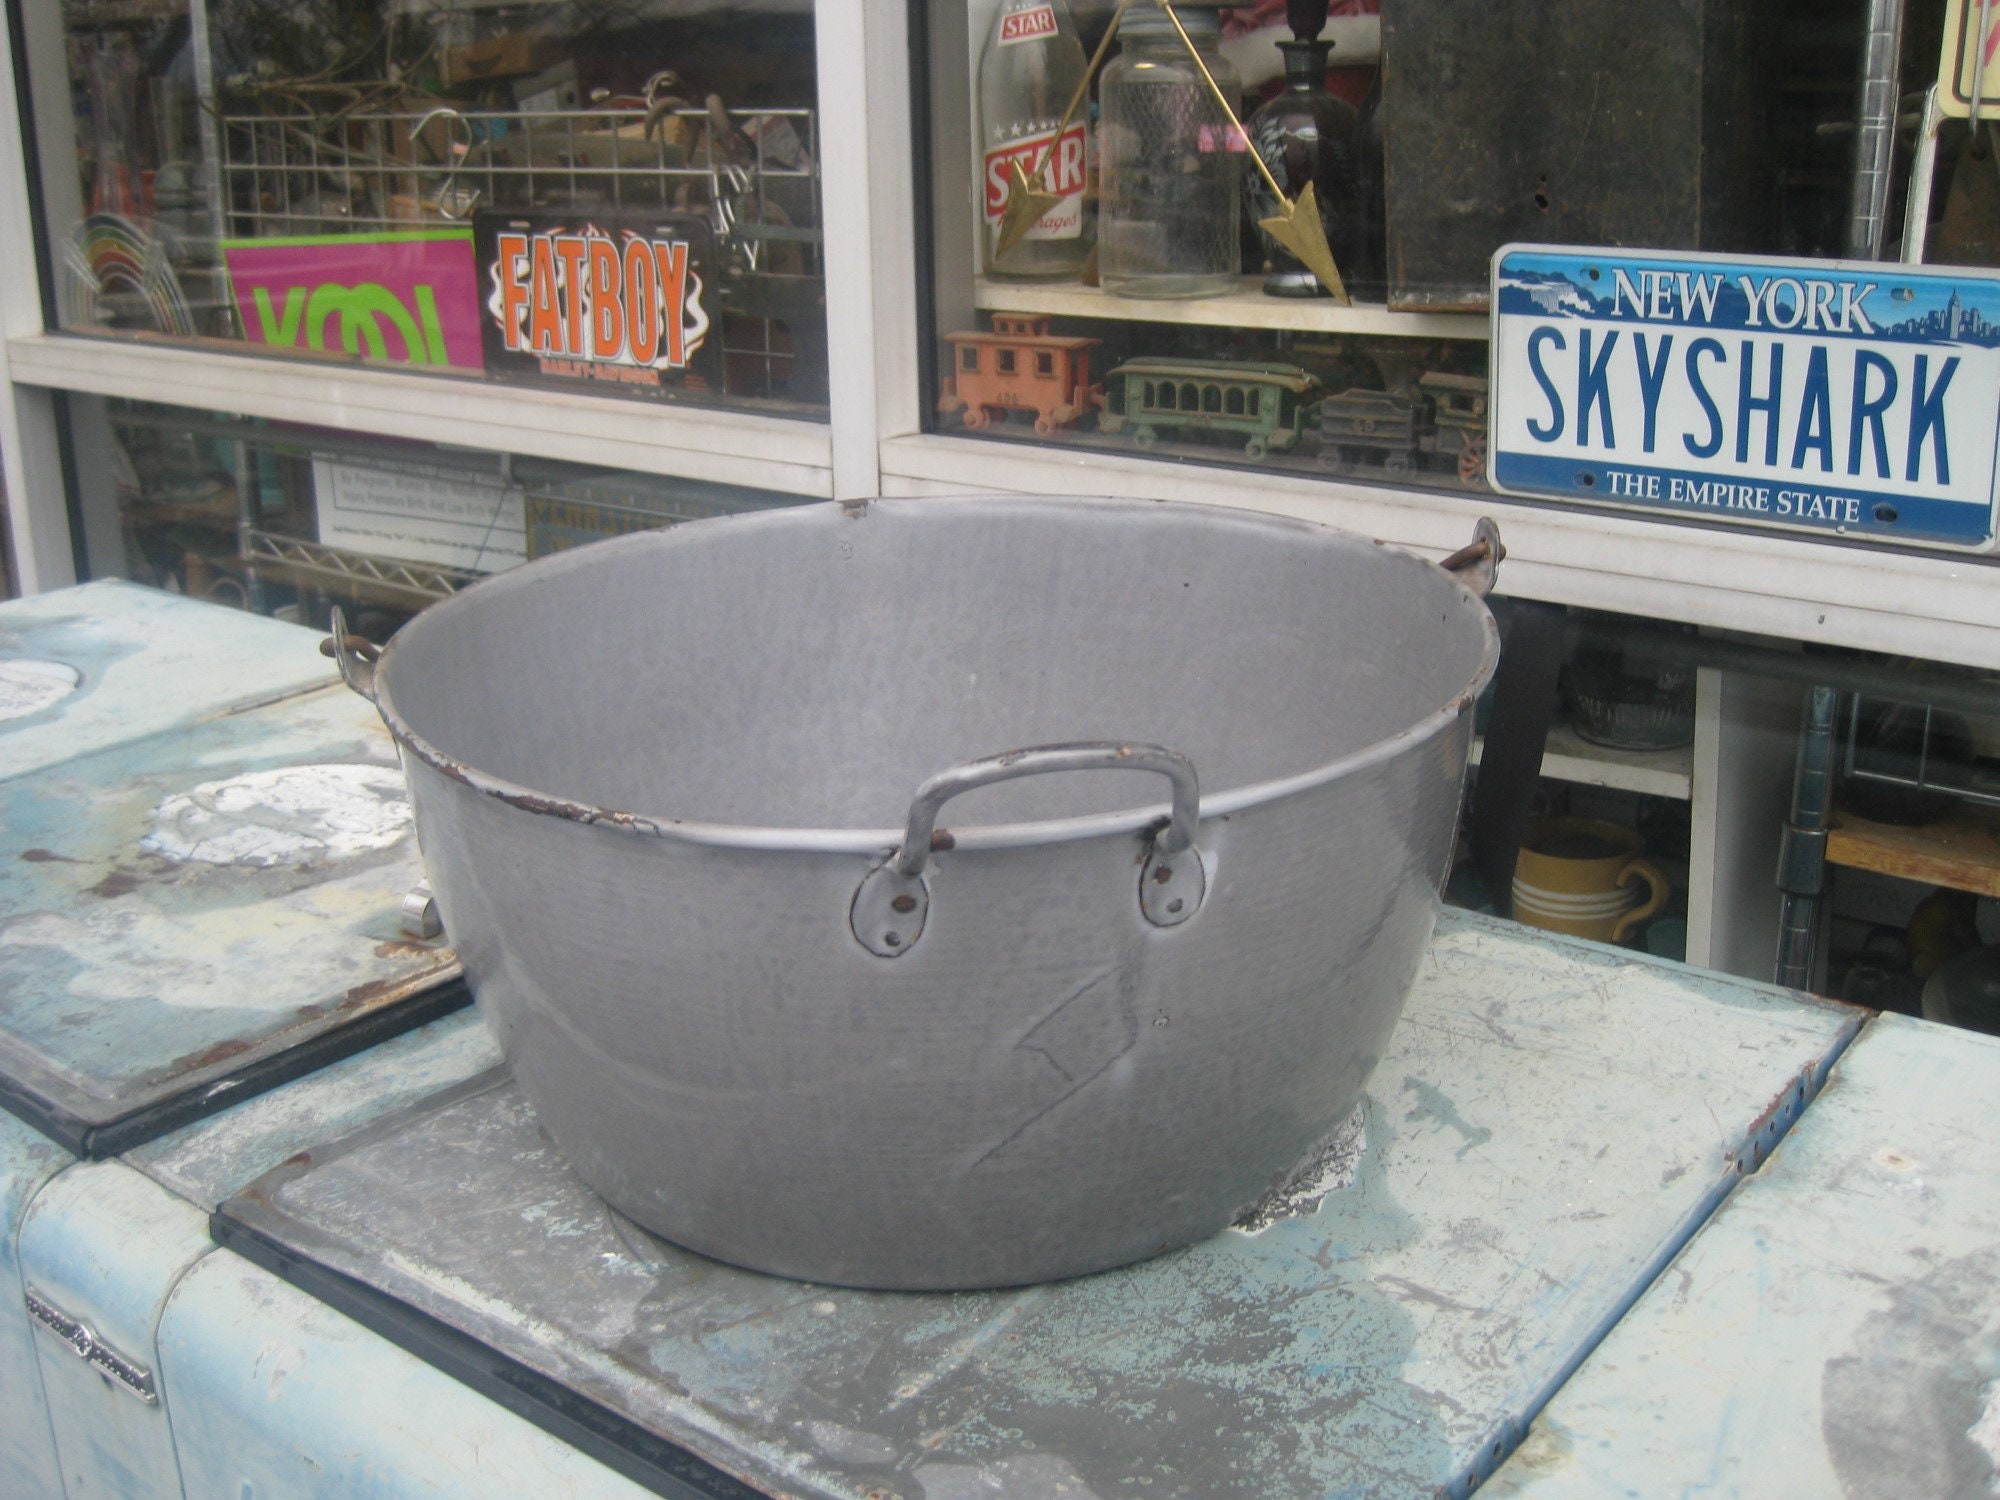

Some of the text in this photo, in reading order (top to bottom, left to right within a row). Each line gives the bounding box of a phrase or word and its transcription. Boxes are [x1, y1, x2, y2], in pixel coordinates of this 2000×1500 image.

[1005, 12, 1051, 37] STAR
[498, 234, 689, 367] FATBOY
[1611, 268, 1878, 335] NEW YORK
[1526, 326, 1961, 485] SKYSHARK
[1606, 470, 1861, 523] THE EMPIRE STATE
